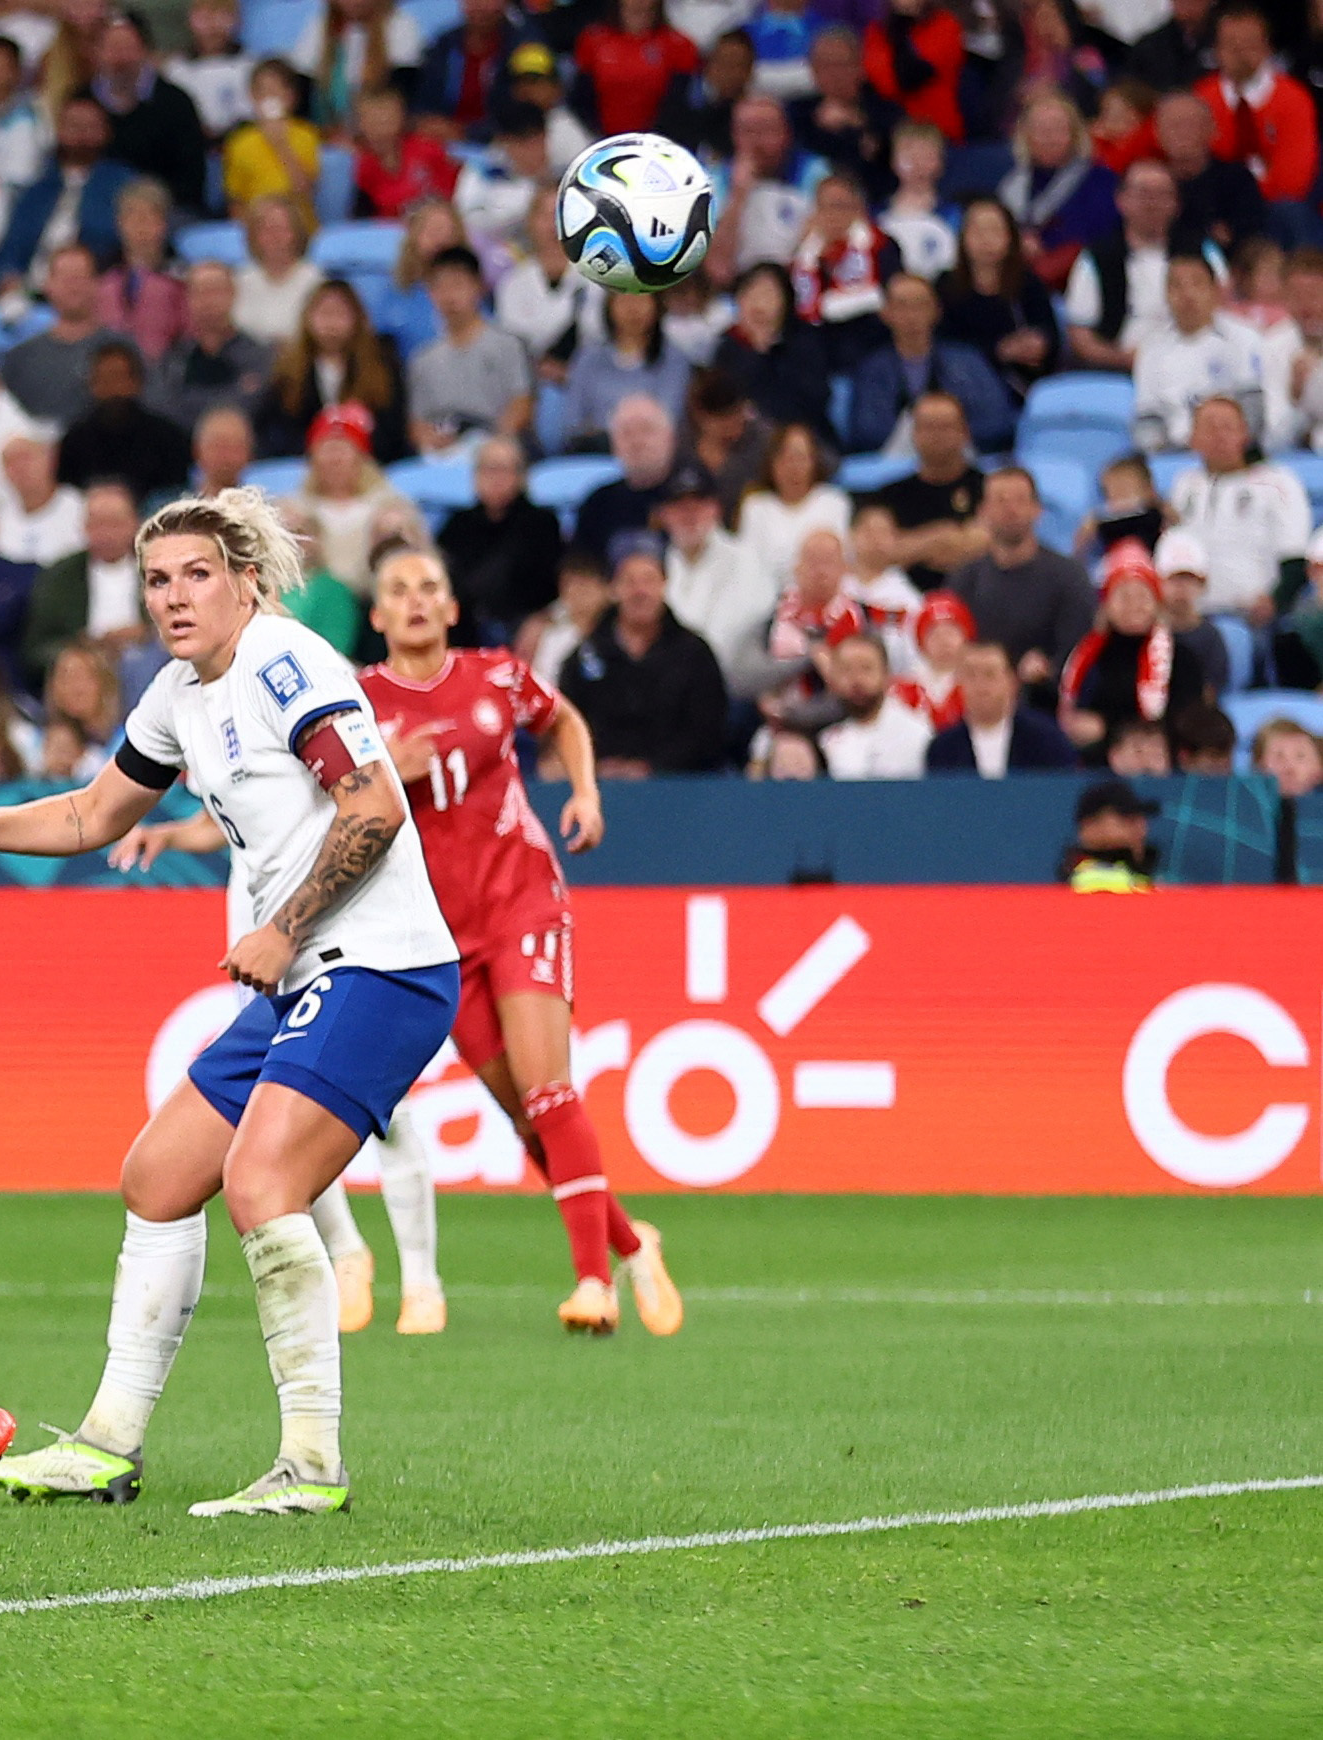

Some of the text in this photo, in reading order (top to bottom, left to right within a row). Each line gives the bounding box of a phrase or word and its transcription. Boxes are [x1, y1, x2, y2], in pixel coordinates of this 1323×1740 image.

[429, 747, 469, 812] 11
[209, 792, 246, 849] 6
[287, 975, 332, 1029] 6
[147, 982, 780, 1188] Caro
